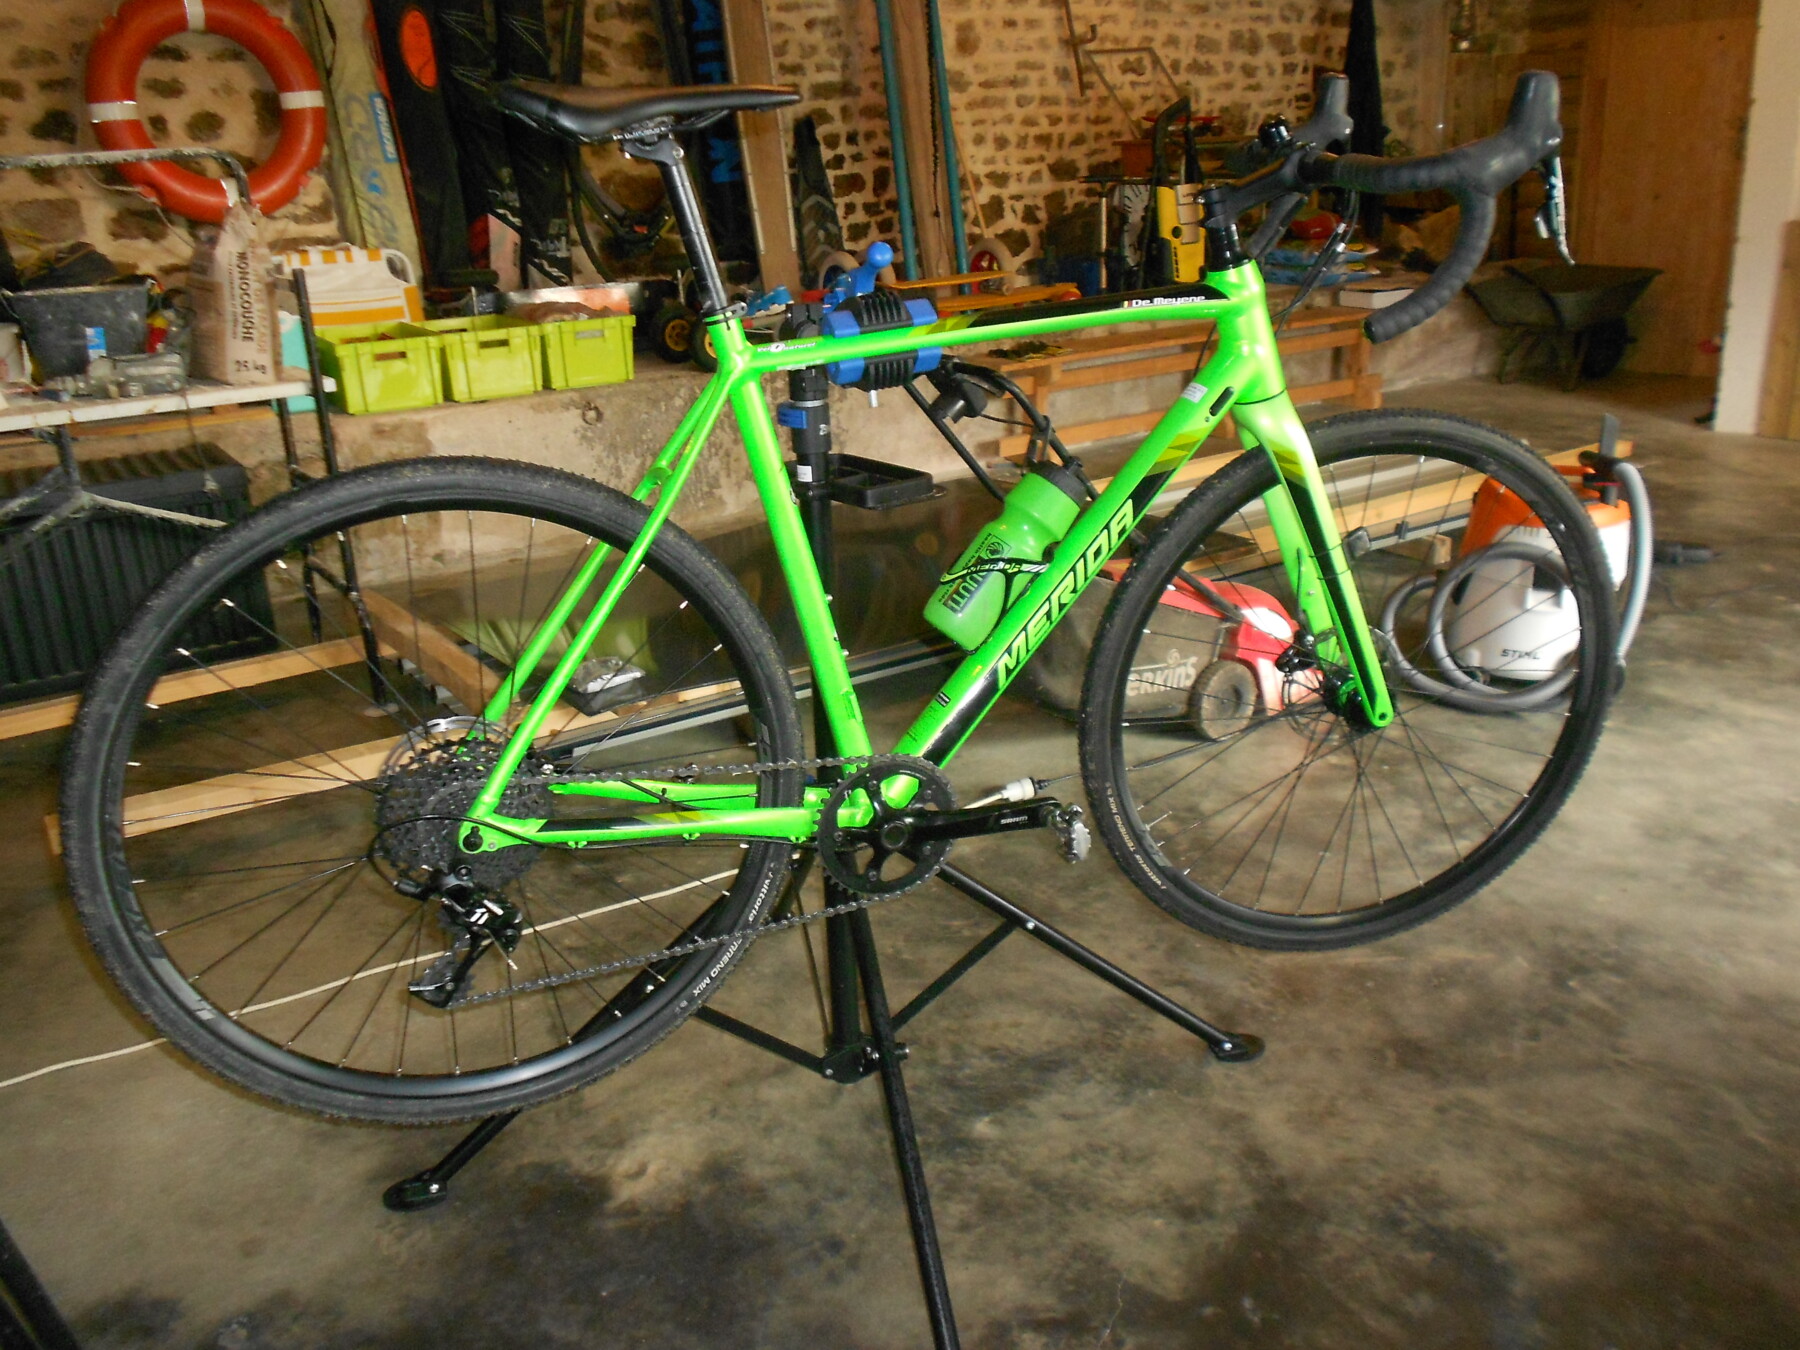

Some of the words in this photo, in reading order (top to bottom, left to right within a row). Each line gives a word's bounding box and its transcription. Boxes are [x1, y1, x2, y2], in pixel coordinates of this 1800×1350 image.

[237, 252, 255, 341] MONOCOUCHE
[1132, 299, 1153, 307] De
[235, 360, 249, 371] 25
[997, 498, 1134, 689] MERIDA
[1108, 797, 1118, 813] MIX
[1001, 816, 1028, 824] SRAM
[693, 976, 711, 996] MIX
